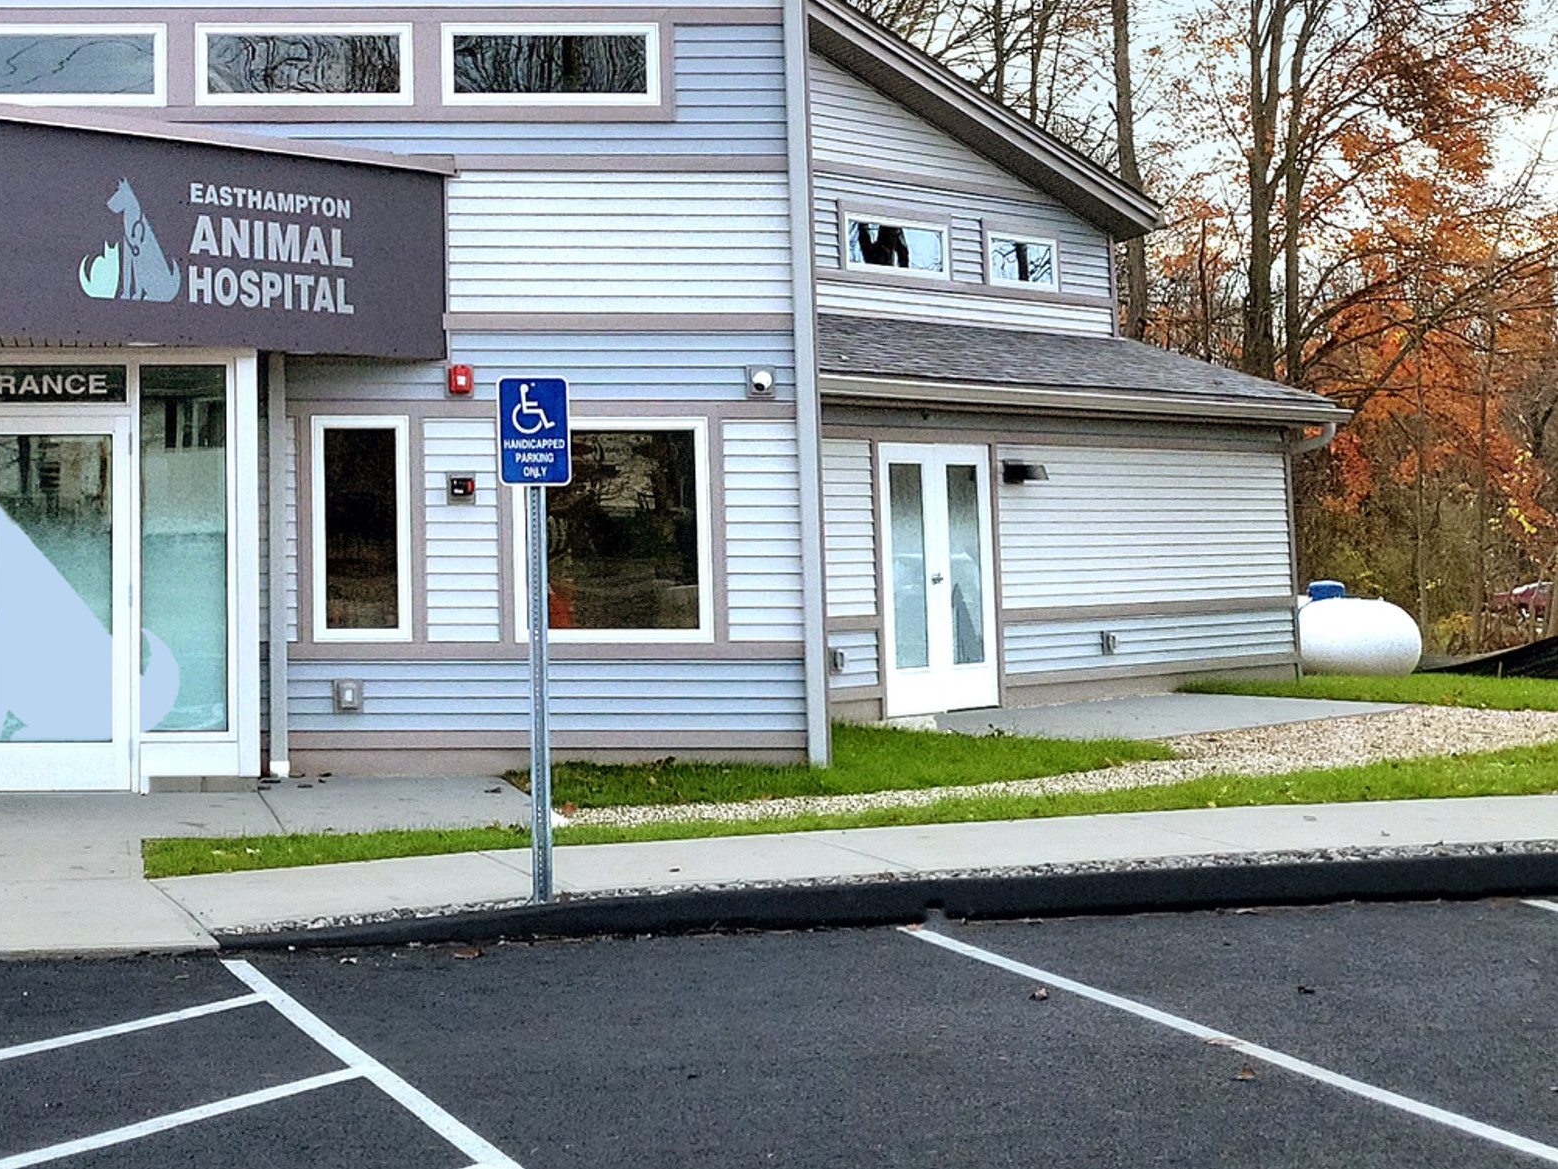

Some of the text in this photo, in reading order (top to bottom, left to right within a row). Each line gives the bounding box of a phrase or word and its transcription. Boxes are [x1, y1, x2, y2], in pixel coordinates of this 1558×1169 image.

[190, 182, 351, 219] EASTHAMPTON
[189, 215, 354, 268] ANIMAL
[188, 265, 355, 314] HOSPITAL
[503, 438, 565, 449] HANDICAPPED
[515, 452, 554, 463] PARKING
[523, 466, 547, 477] ONLY
